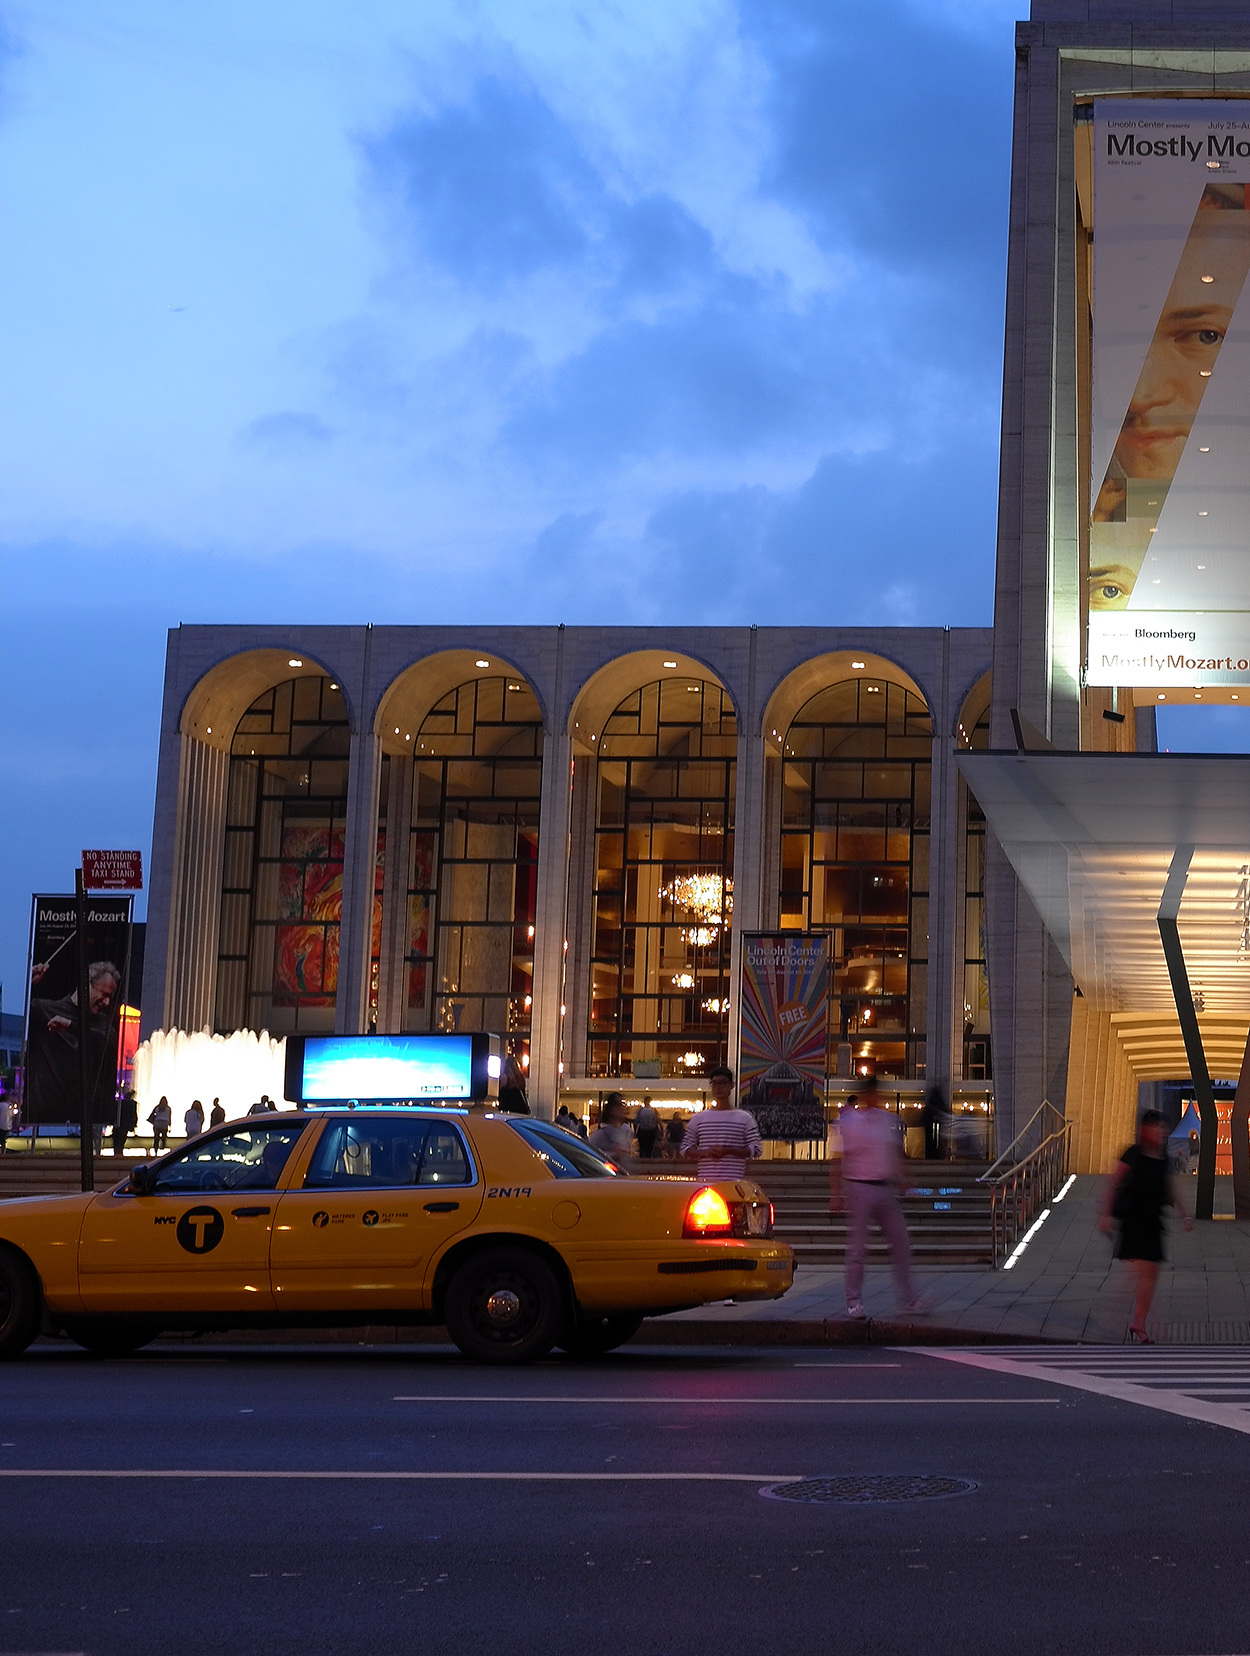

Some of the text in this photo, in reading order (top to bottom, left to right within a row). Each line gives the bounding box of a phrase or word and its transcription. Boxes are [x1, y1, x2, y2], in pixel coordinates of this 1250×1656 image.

[1107, 120, 1137, 129] Lincoln
[1138, 120, 1164, 129] Center
[1208, 122, 1225, 131] July
[1107, 133, 1203, 163] Mostly
[1135, 628, 1196, 642] Bloomberg
[86, 852, 138, 861] NO STANDING
[93, 861, 132, 870] ANYTIME
[91, 869, 135, 878] TAXI STAND
[747, 945, 825, 956] Lincoln Center
[746, 956, 815, 966] Out of Doors
[778, 1005, 808, 1027] FREE
[487, 1186, 533, 1199] 2N19
[154, 1214, 215, 1249] NYC T
